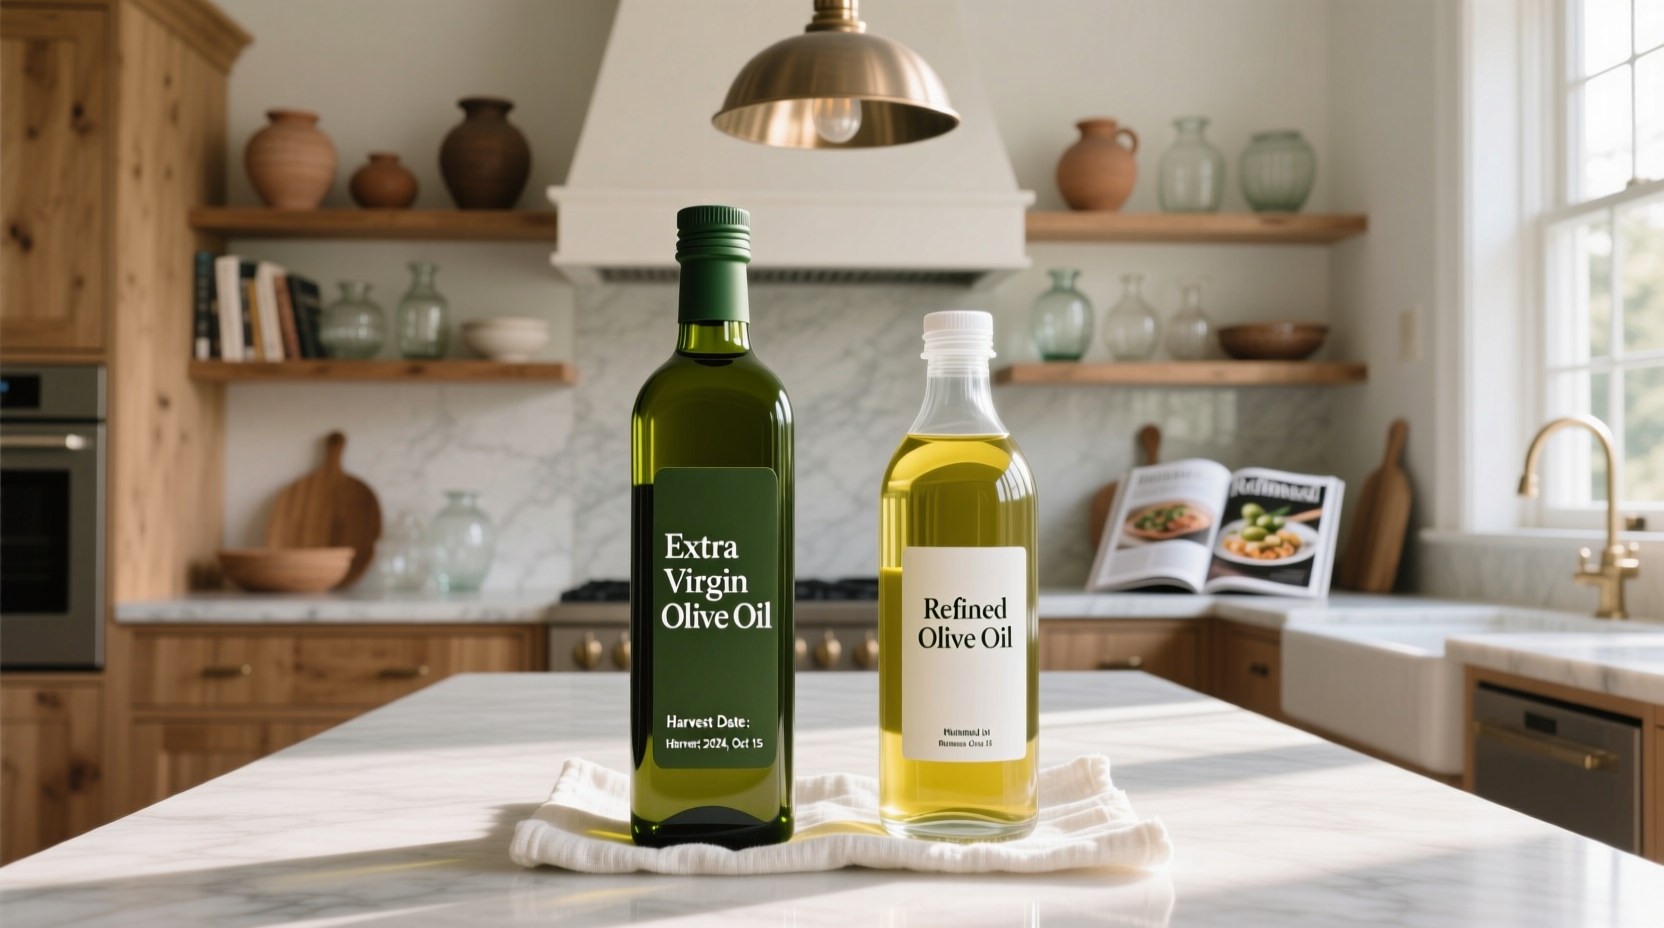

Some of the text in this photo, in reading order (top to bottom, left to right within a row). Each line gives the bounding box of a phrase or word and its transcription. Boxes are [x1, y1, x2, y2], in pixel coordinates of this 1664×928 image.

[665, 533, 739, 559] Extra
[663, 568, 748, 602] Virgin
[661, 601, 772, 629] Olive Oil
[924, 597, 1006, 619] Refined
[918, 625, 1012, 648] Olive Oil
[667, 714, 750, 728] Harvest Date:
[702, 738, 729, 751] 2024,
[732, 738, 749, 748] Oct
[753, 738, 763, 748] 15
